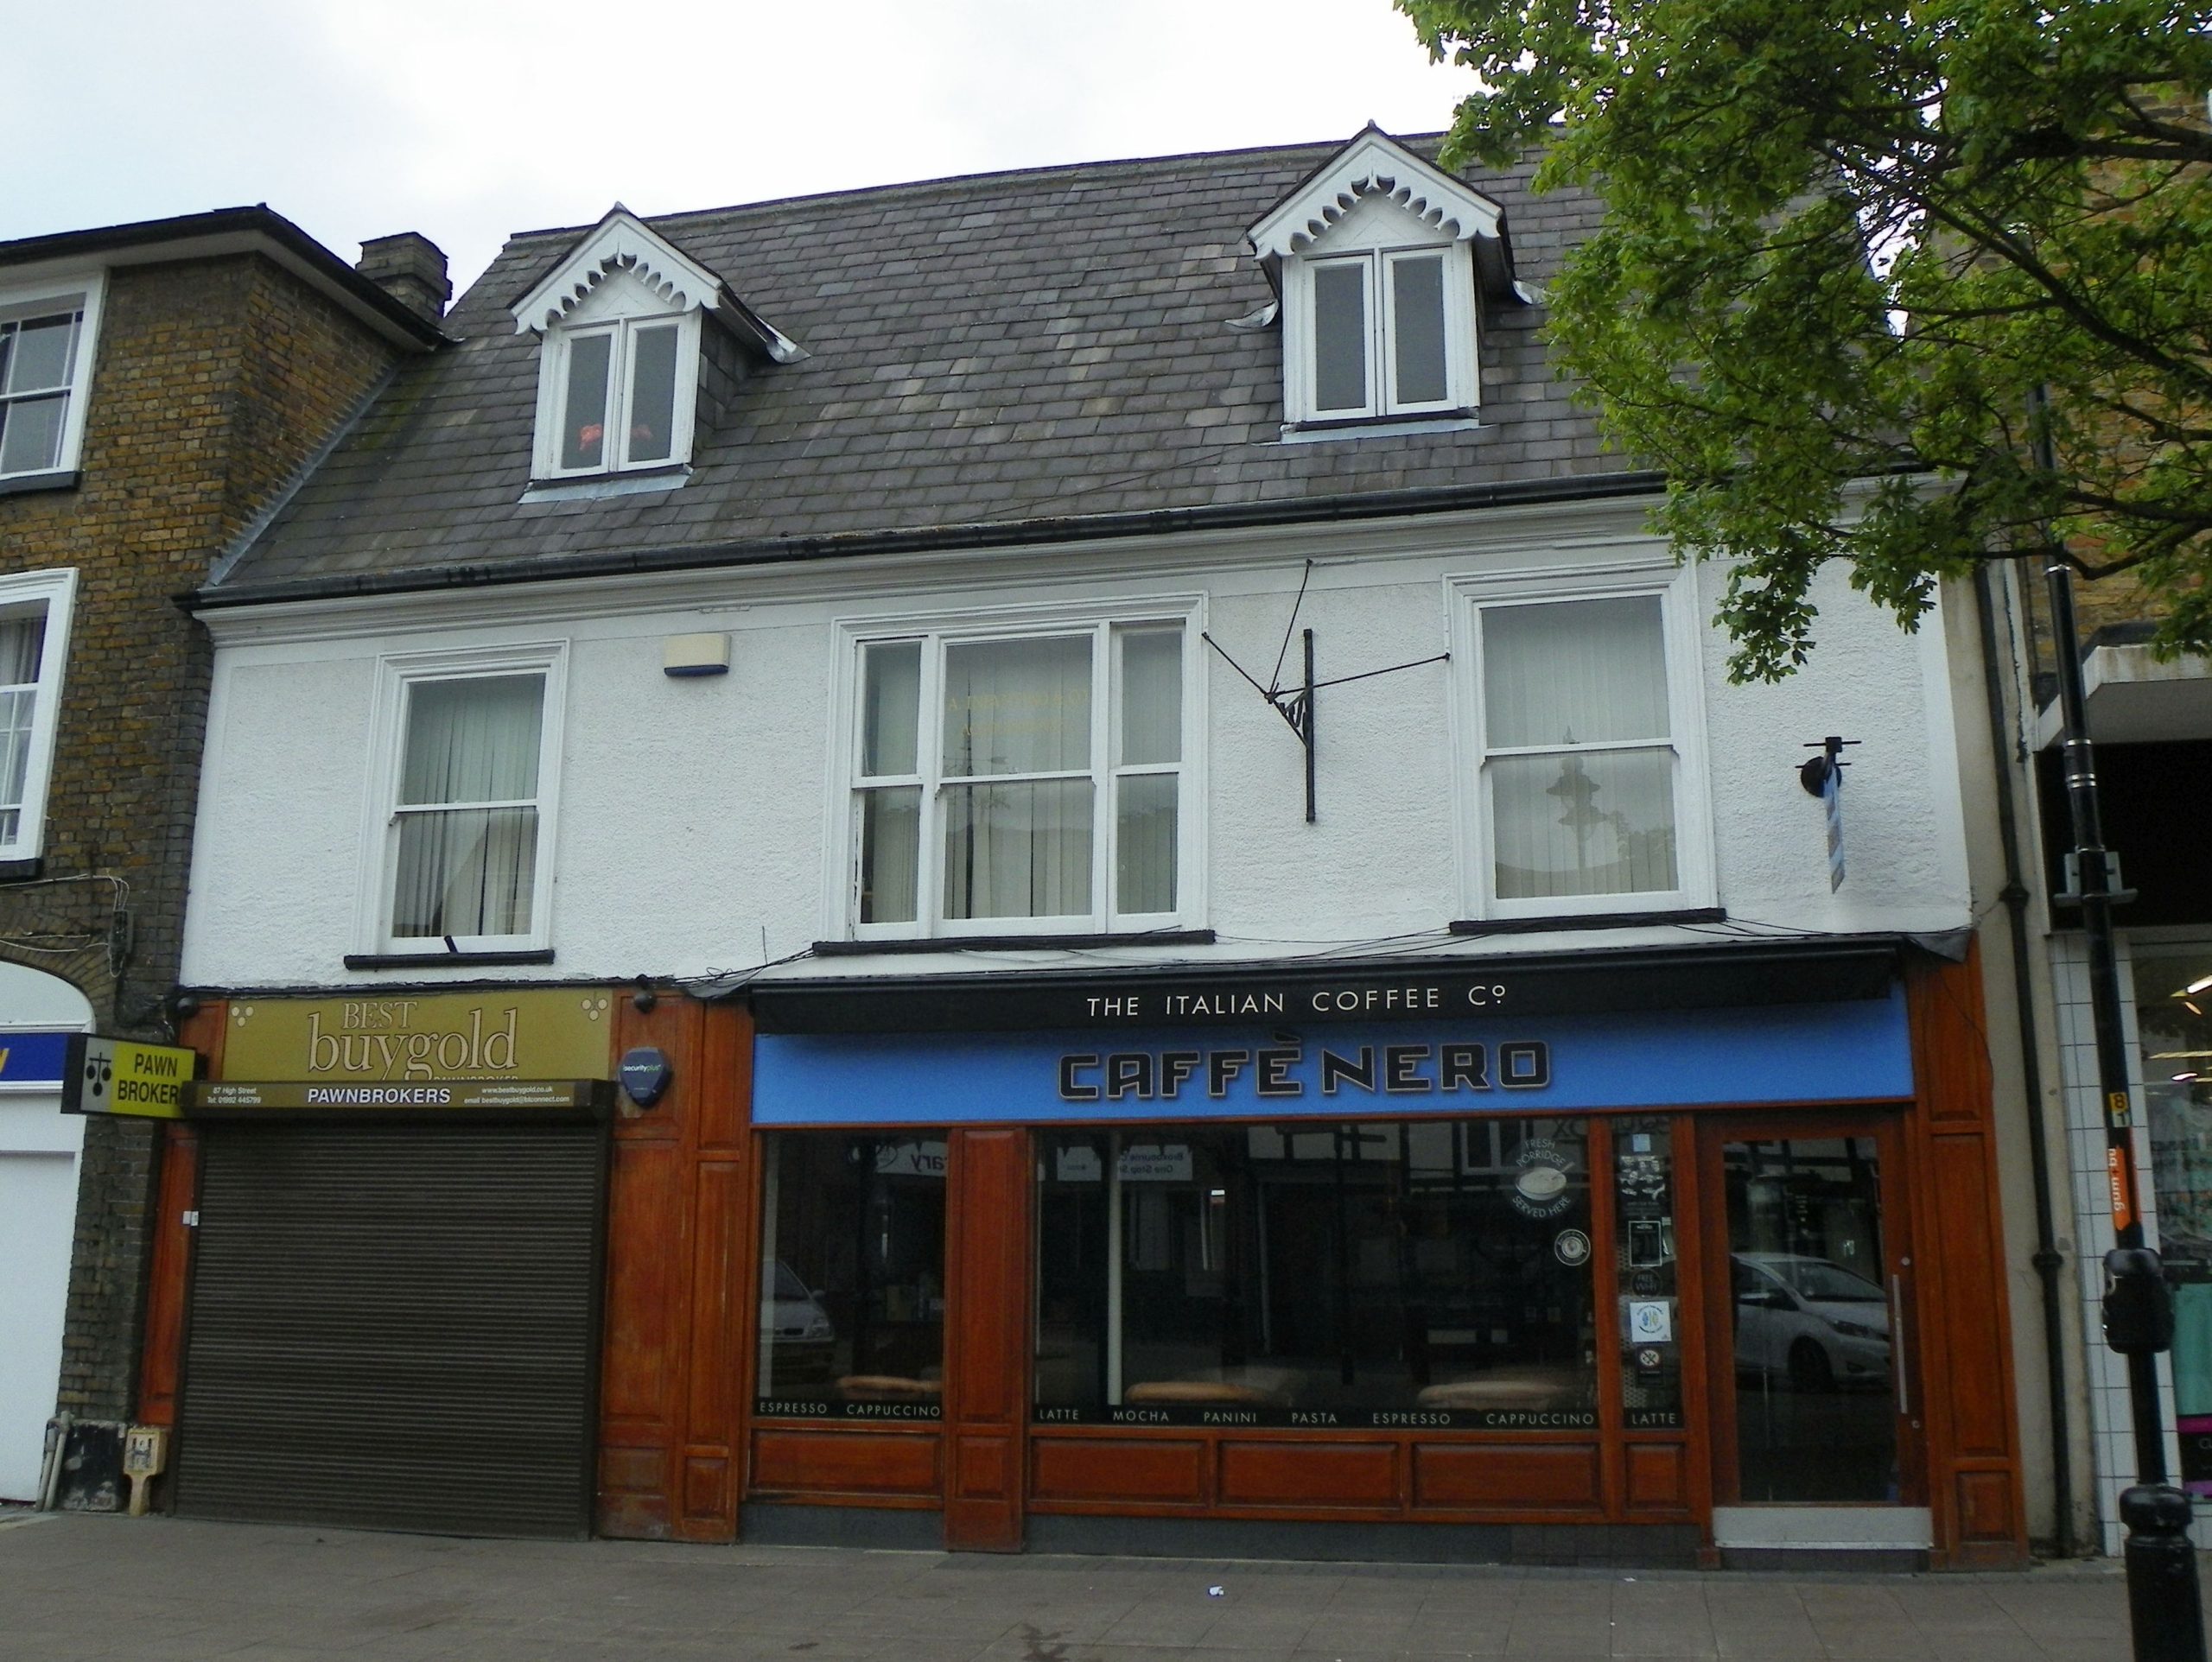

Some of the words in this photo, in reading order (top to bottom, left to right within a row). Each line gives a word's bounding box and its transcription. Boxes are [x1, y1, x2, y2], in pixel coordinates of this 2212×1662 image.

[1086, 997, 1140, 1018] THE
[1165, 993, 1285, 1016] ITALIAN
[1312, 987, 1440, 1012] COFFEE
[342, 1000, 417, 1030] BEST
[308, 1006, 518, 1081] buygold
[134, 1052, 178, 1078] PAWN
[1321, 1041, 1551, 1094] NERO
[222, 1087, 237, 1095] High
[307, 1087, 451, 1104] PAWNBROKERS
[481, 1086, 553, 1094] www.bestbuygold.co.uk
[2113, 1094, 2125, 1109] 8
[1524, 1139, 1555, 1150] FRESH
[1516, 1149, 1567, 1167] PORRIDGE
[2111, 1177, 2125, 1211] gum
[1512, 1196, 1547, 1218] SERVED
[1548, 1196, 1571, 1217] HERE
[759, 1402, 828, 1415] ESPRESSO
[846, 1404, 941, 1418] CAPPUCCINO
[1039, 1409, 1079, 1421] LATTE
[1112, 1410, 1169, 1423] MOCHA
[1203, 1411, 1257, 1424] PANINI
[1291, 1412, 1337, 1424] PASTA
[1372, 1412, 1451, 1424] ESPRESSO
[1485, 1412, 1594, 1424] CAPPUCCINO
[1631, 1412, 1676, 1424] LATTE
